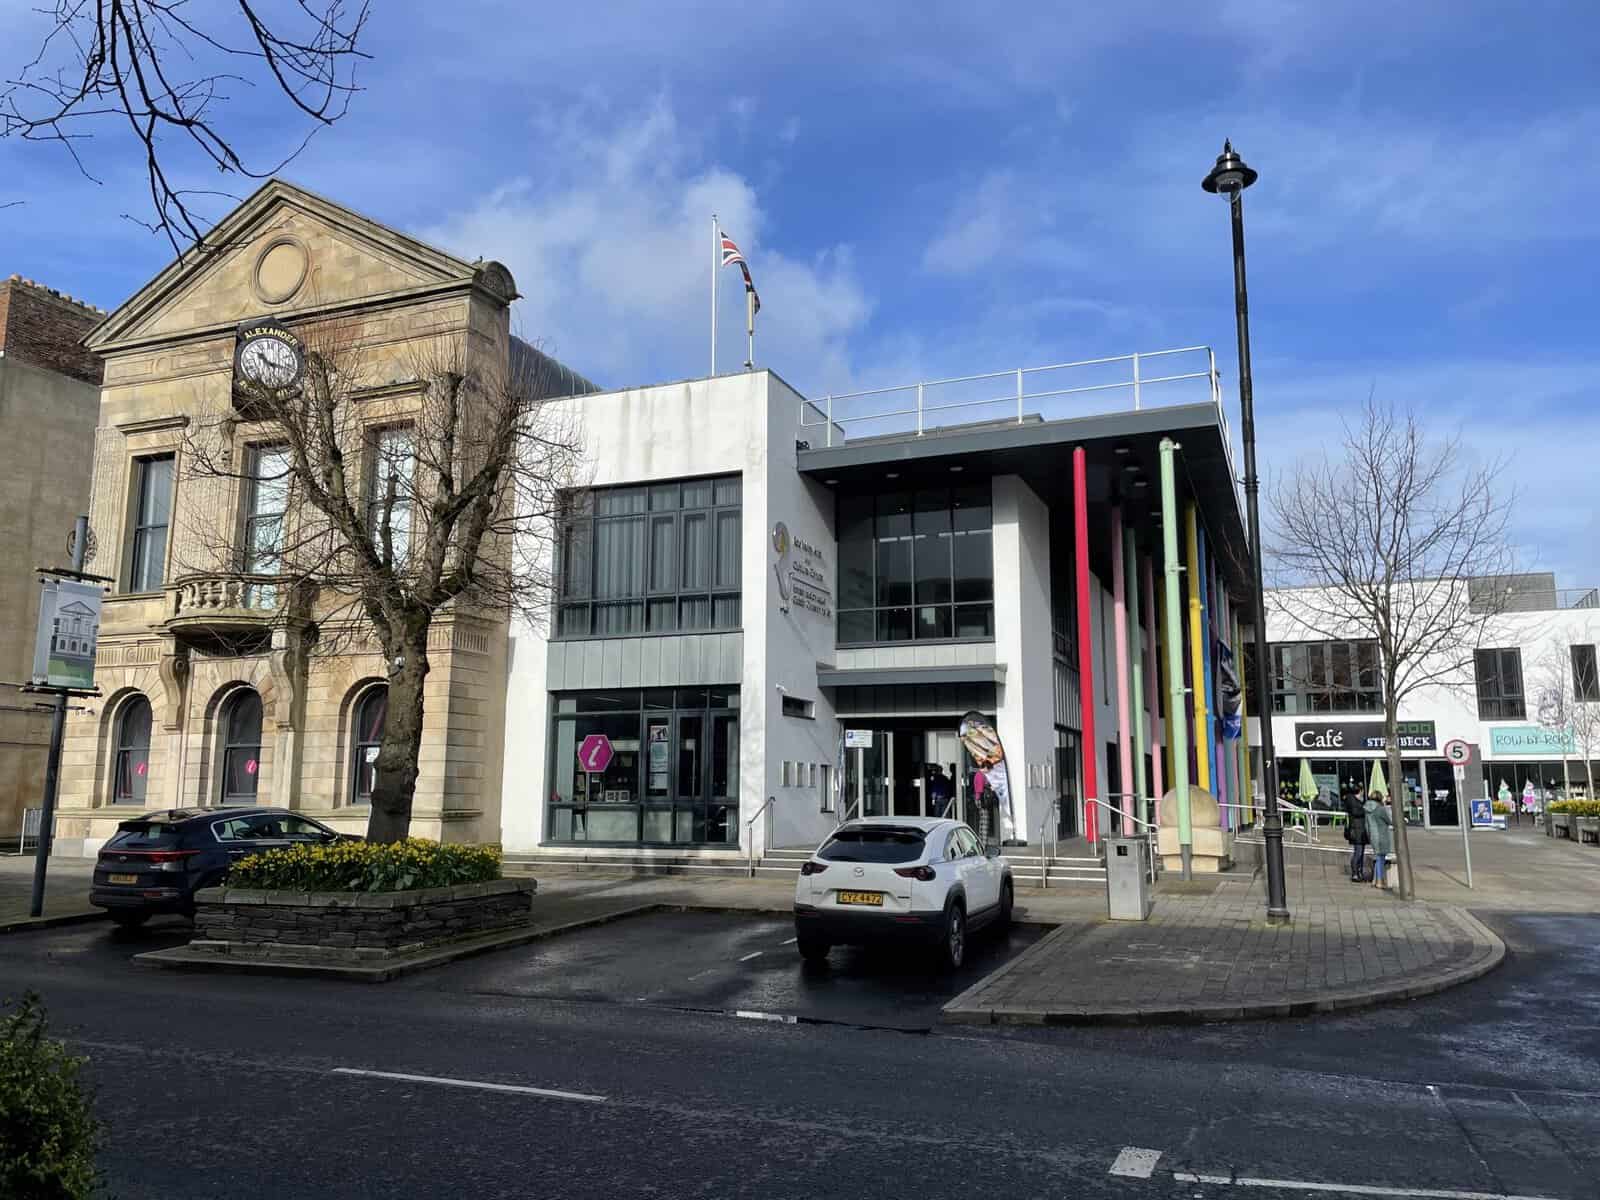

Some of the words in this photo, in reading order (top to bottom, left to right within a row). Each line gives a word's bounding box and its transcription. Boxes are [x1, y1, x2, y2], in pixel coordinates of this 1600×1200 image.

[244, 327, 298, 346] ALEXANDER
[1299, 729, 1343, 747] Café
[1367, 736, 1430, 747] STEBECK
[1452, 745, 1463, 759] 5
[1265, 760, 1272, 769] 7
